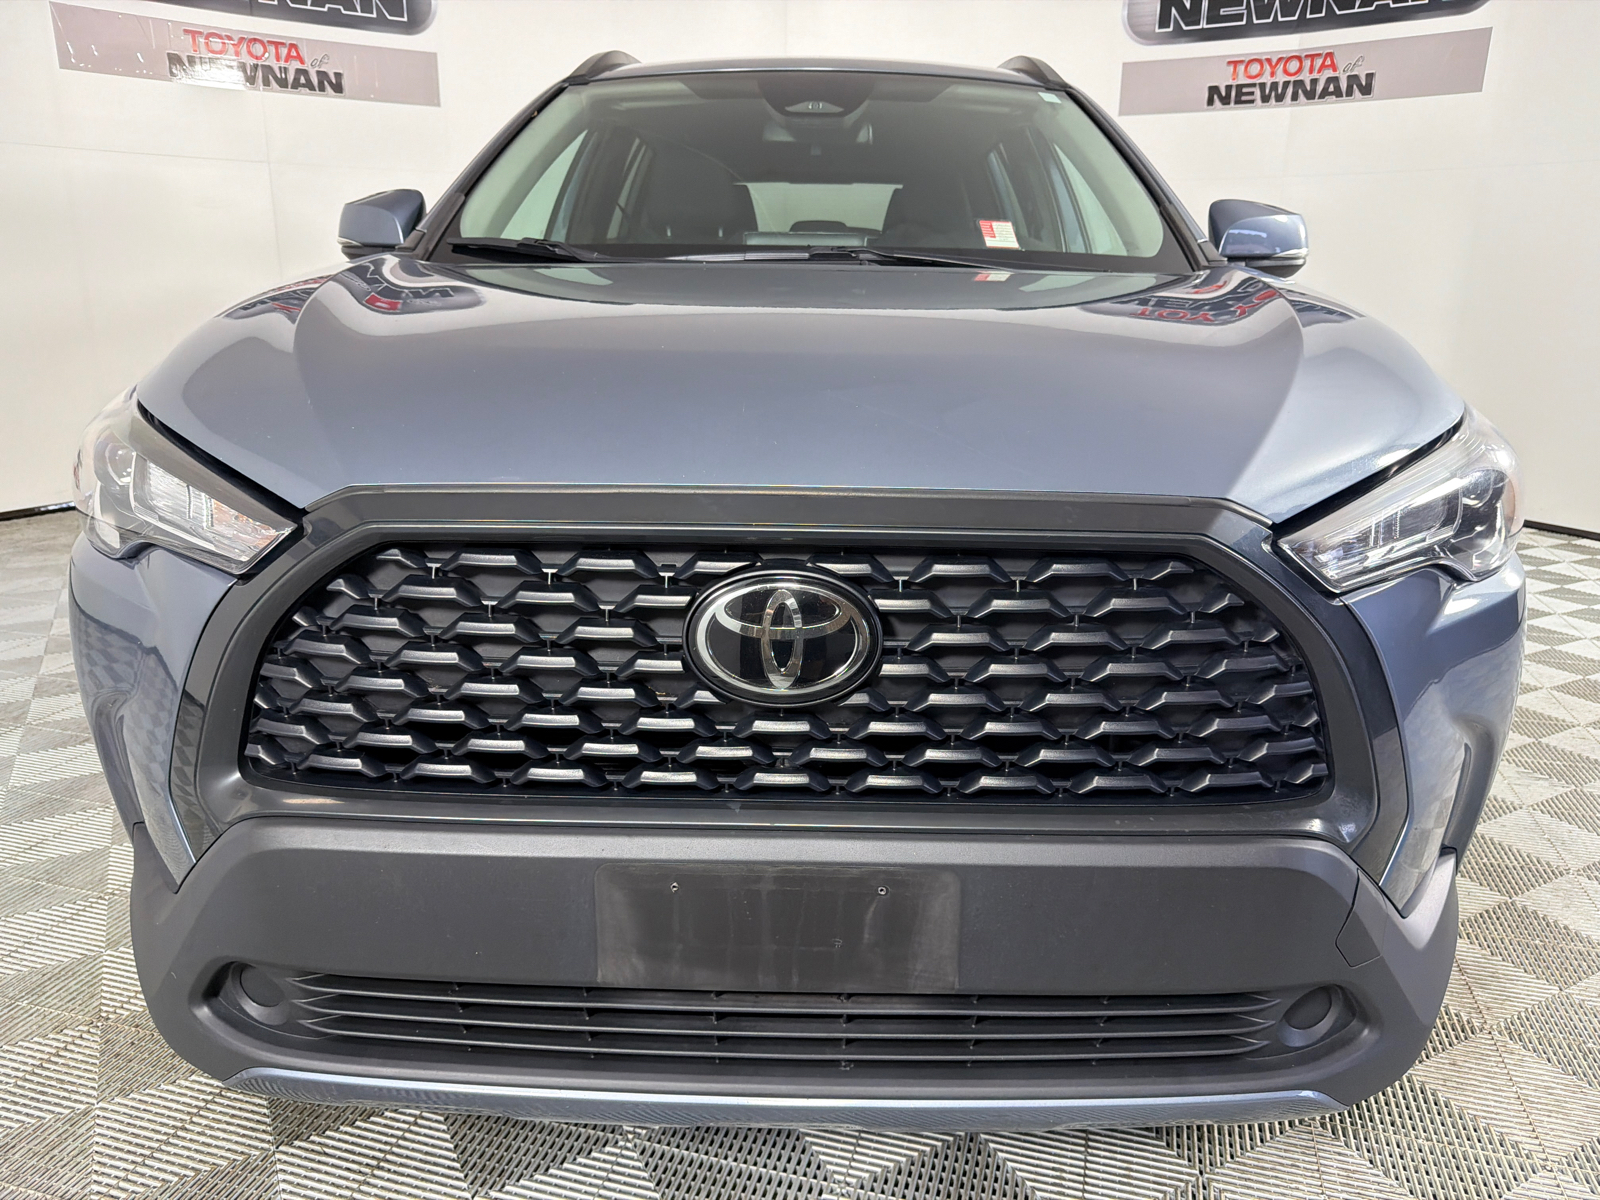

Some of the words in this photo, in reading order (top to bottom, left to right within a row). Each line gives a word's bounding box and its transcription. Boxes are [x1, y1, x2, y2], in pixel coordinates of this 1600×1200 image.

[1155, 0, 1429, 32] NEW
[183, 28, 306, 66] TOYOTA
[310, 53, 330, 69] of
[1226, 51, 1338, 81] TOYOTA
[1342, 55, 1365, 74] of
[166, 51, 344, 95] NWNAN
[1206, 72, 1375, 107] NEWNAN
